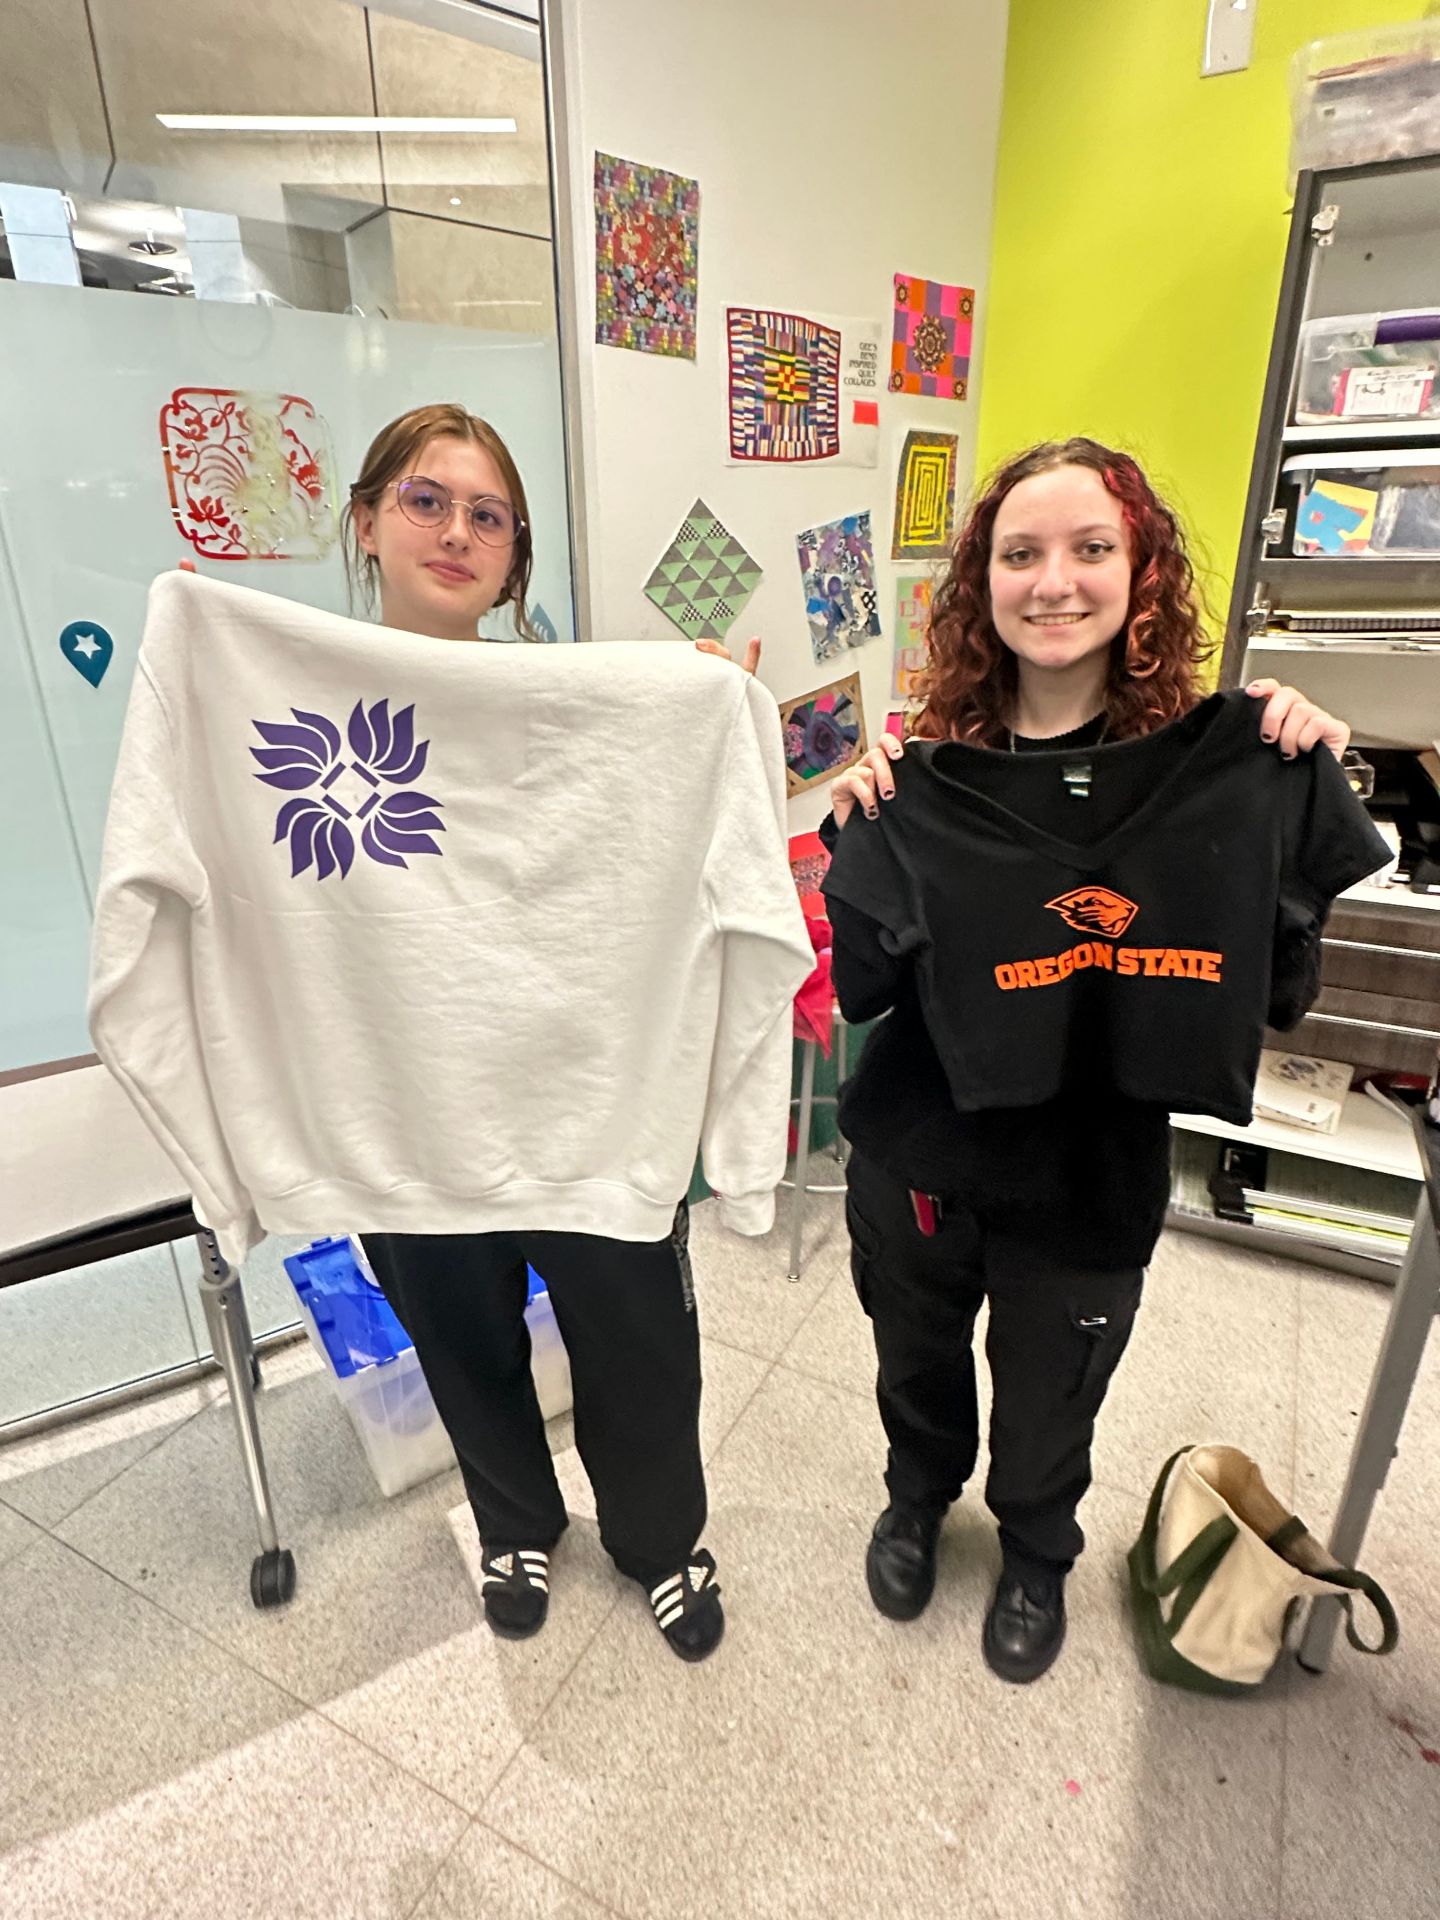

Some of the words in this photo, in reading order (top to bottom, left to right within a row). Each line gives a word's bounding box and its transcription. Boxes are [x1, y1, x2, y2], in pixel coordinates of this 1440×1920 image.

[860, 352, 877, 360] BEND
[849, 360, 877, 369] INSPIRED
[857, 369, 876, 377] QUILT
[843, 377, 876, 386] COLLAGES
[994, 941, 1113, 990] OREGON
[1116, 947, 1223, 983] STATE
